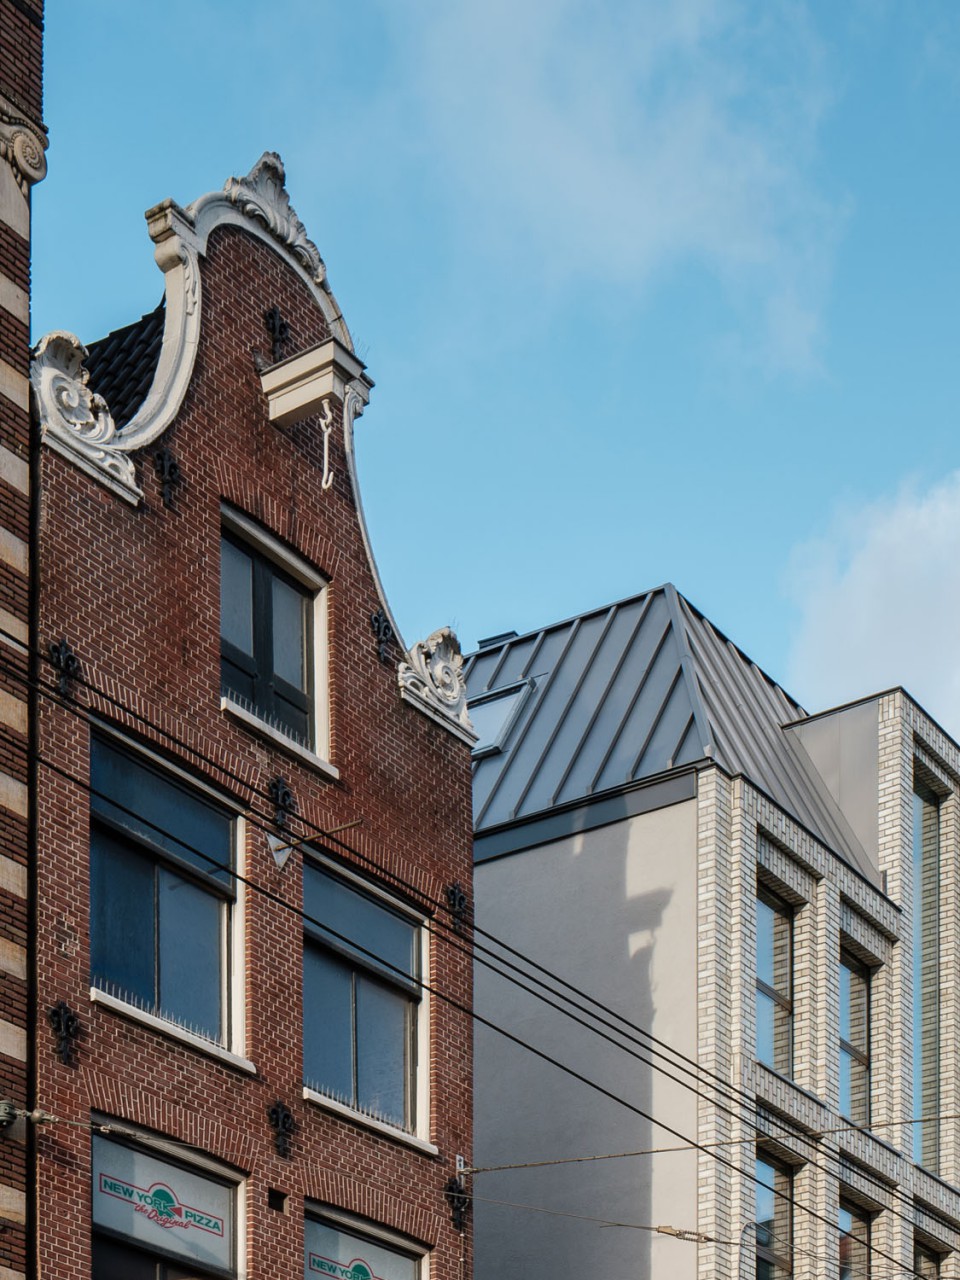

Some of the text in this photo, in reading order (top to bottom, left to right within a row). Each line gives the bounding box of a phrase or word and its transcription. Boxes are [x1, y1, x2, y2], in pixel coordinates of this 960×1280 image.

[103, 1179, 221, 1232] NEW YORK PIZZA
[134, 1203, 192, 1229] the Original
[312, 1258, 337, 1274] NEW
